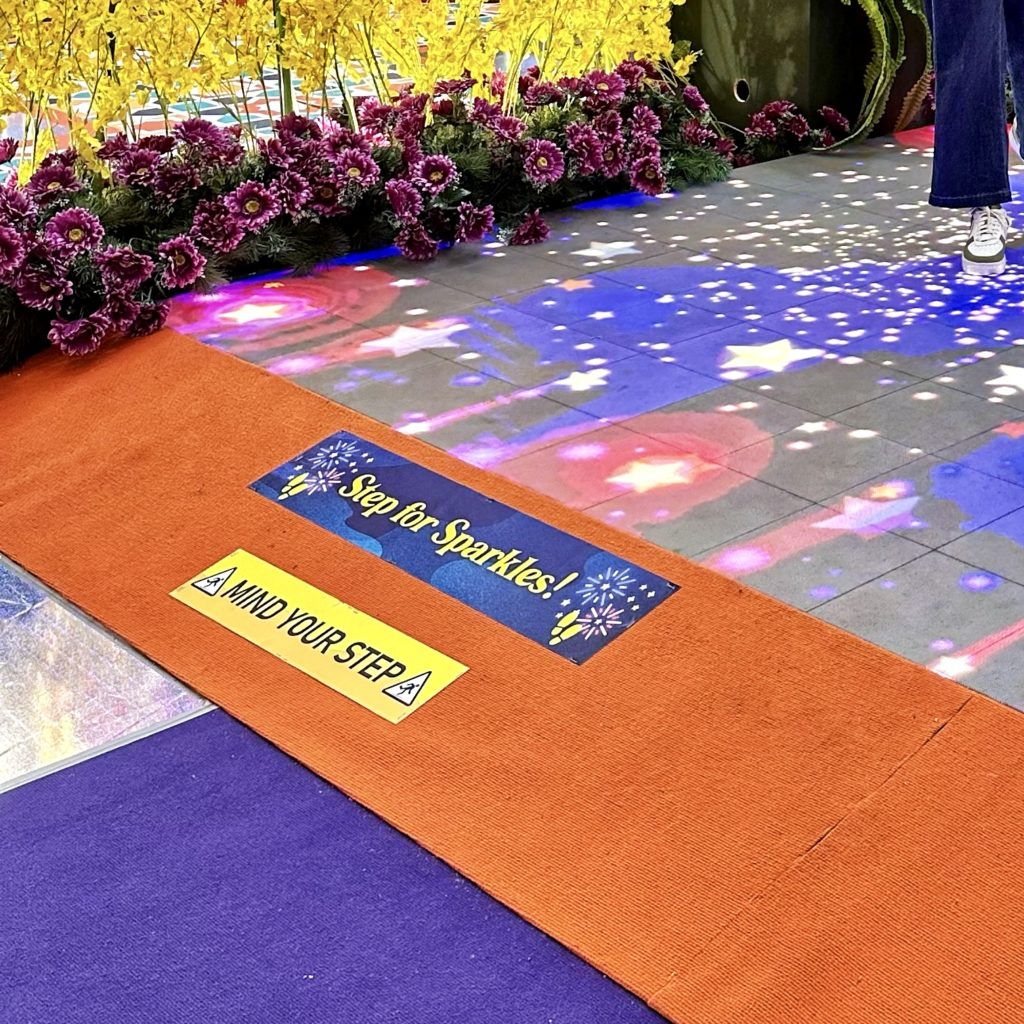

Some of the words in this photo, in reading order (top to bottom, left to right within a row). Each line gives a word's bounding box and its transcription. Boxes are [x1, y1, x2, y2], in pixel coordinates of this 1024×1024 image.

[338, 474, 399, 517] Step
[389, 502, 439, 533] for
[431, 518, 579, 599] Sparkles!
[220, 579, 288, 620] MIND
[276, 607, 347, 655] YOUR
[333, 641, 407, 682] STEP
